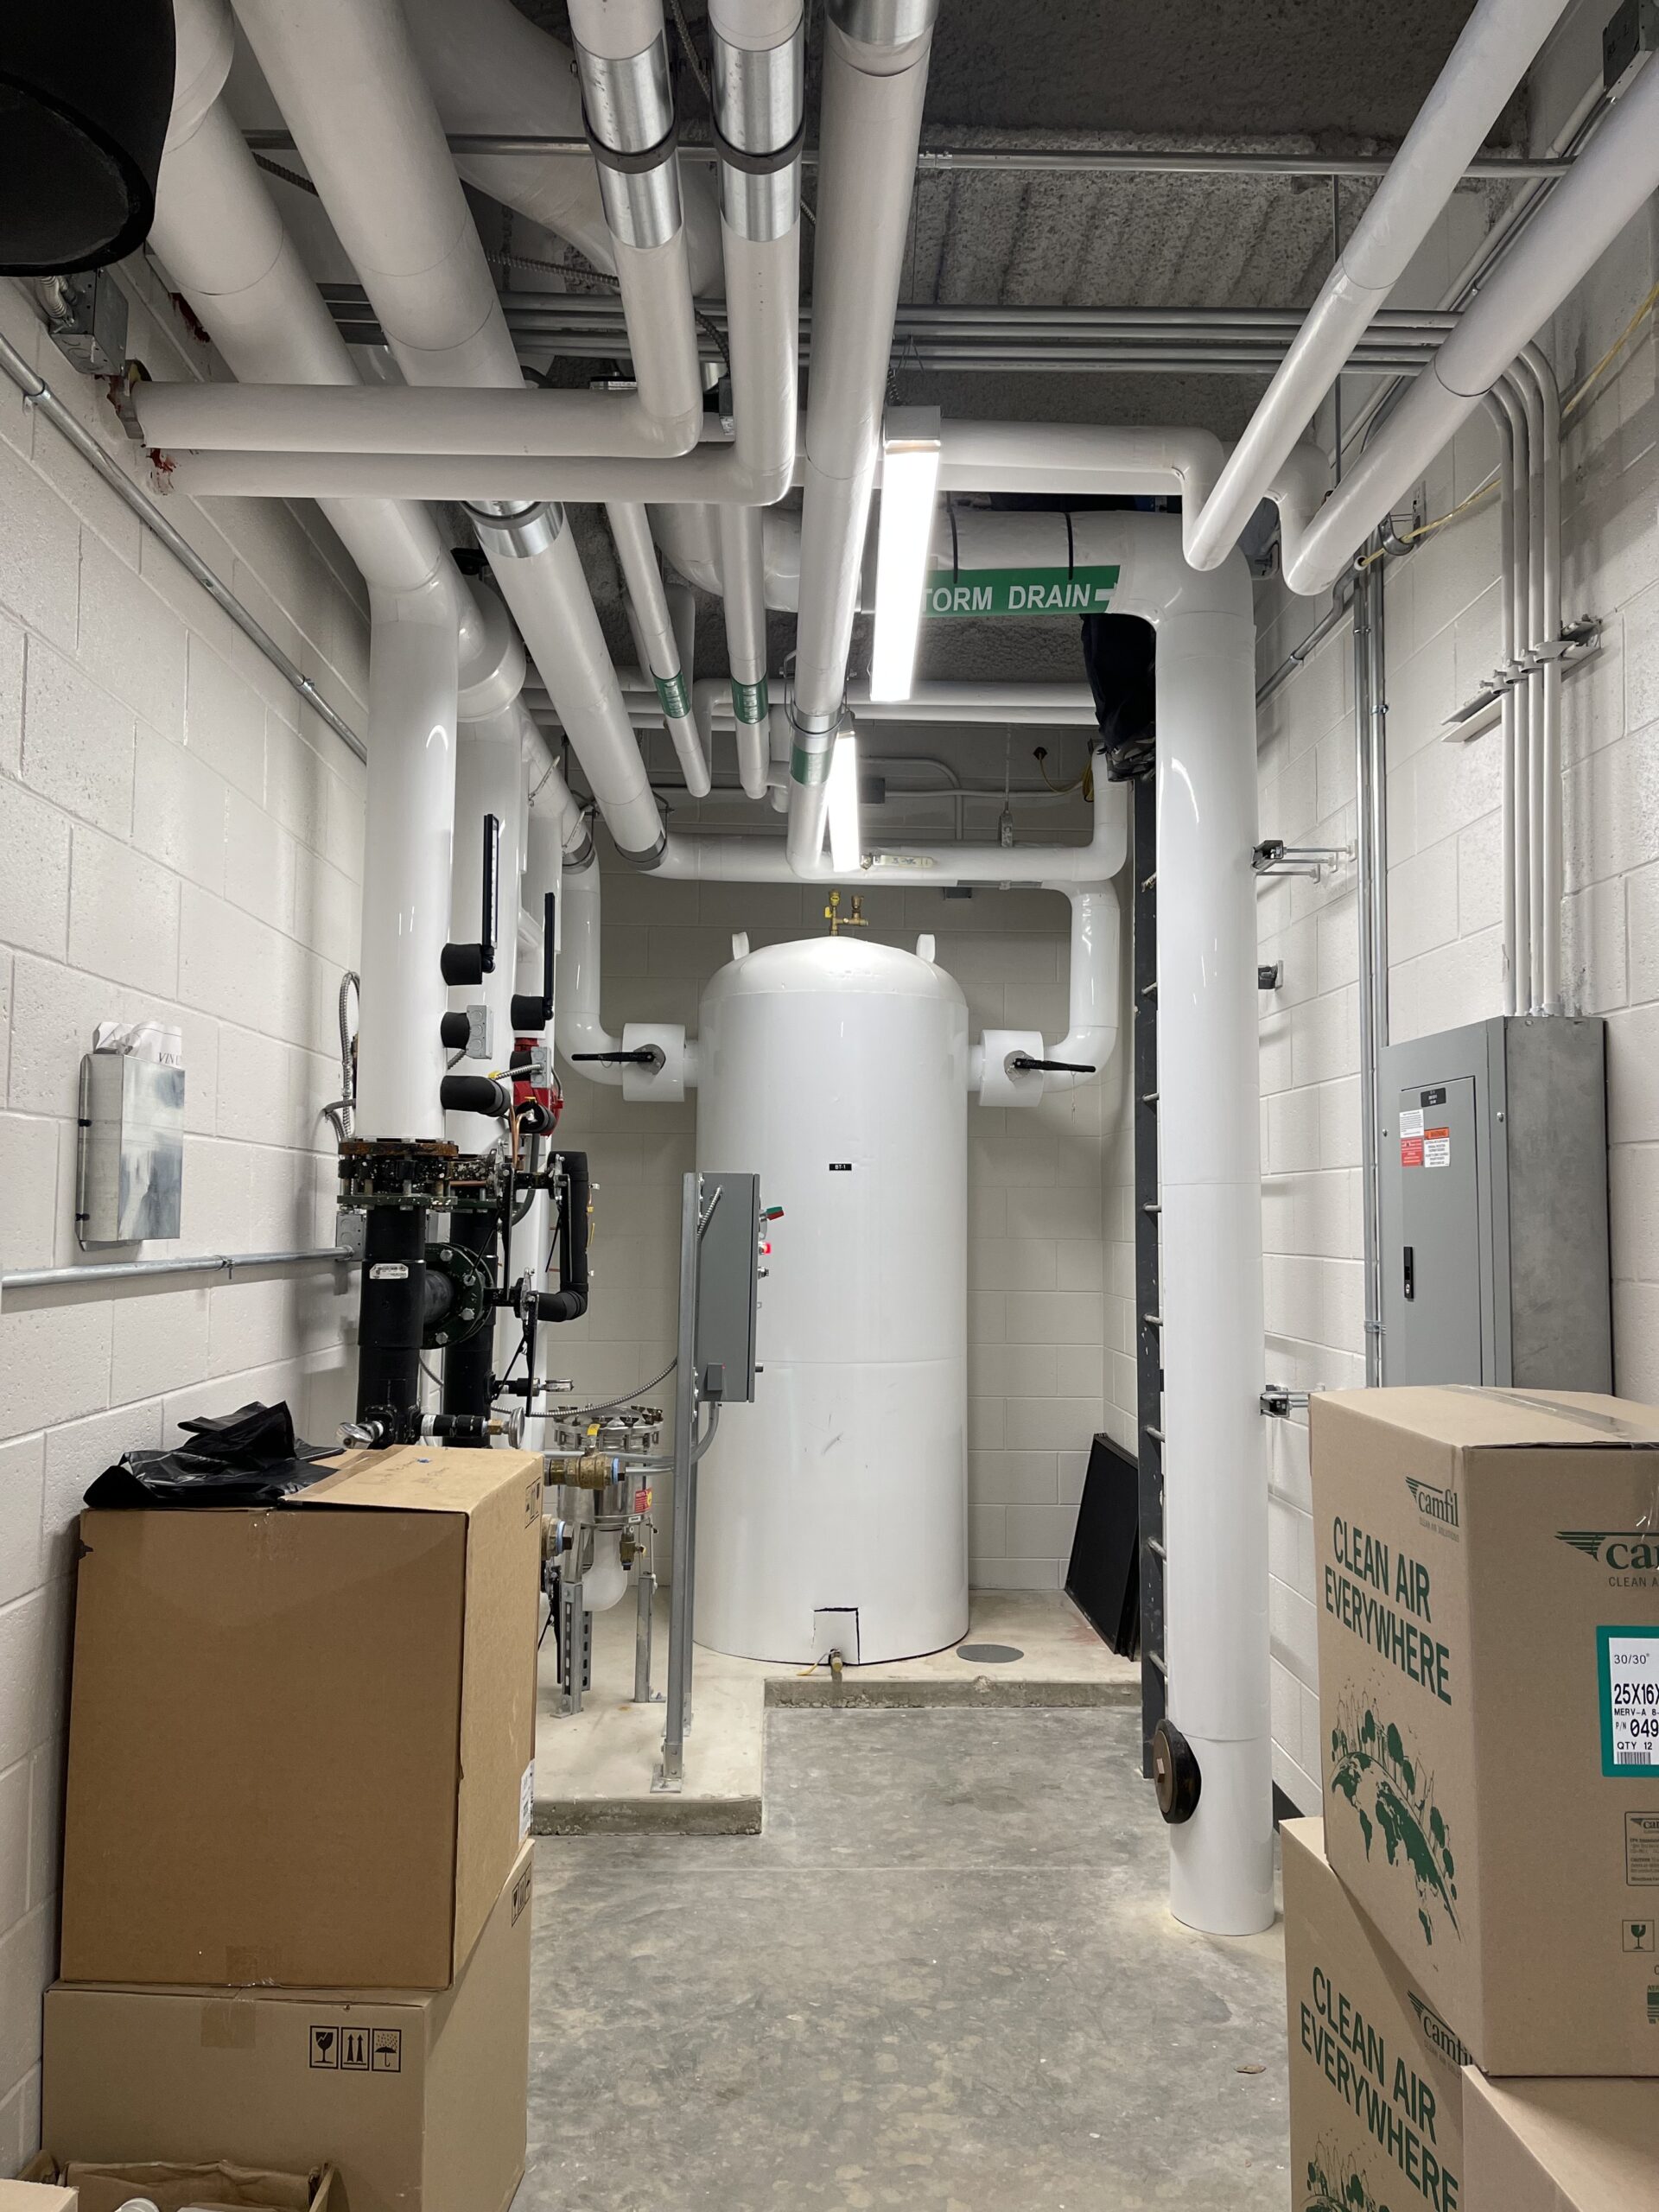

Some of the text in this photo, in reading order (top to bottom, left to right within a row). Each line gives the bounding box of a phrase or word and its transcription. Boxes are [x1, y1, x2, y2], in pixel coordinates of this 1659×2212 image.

[922, 584, 1091, 612] TORM DRAIN
[1418, 1488, 1459, 1528] camfil
[1333, 1516, 1432, 1624] CLEAN AIR
[1608, 1576, 1647, 1587] CLEAN
[1325, 1564, 1452, 1706] EVERYWHERE
[1615, 1719, 1659, 1738] P/N 049
[1617, 1742, 1637, 1751] QTY
[1313, 1966, 1438, 2145] CLEAN AIR
[1300, 2000, 1459, 2212] EVERYWHERE
